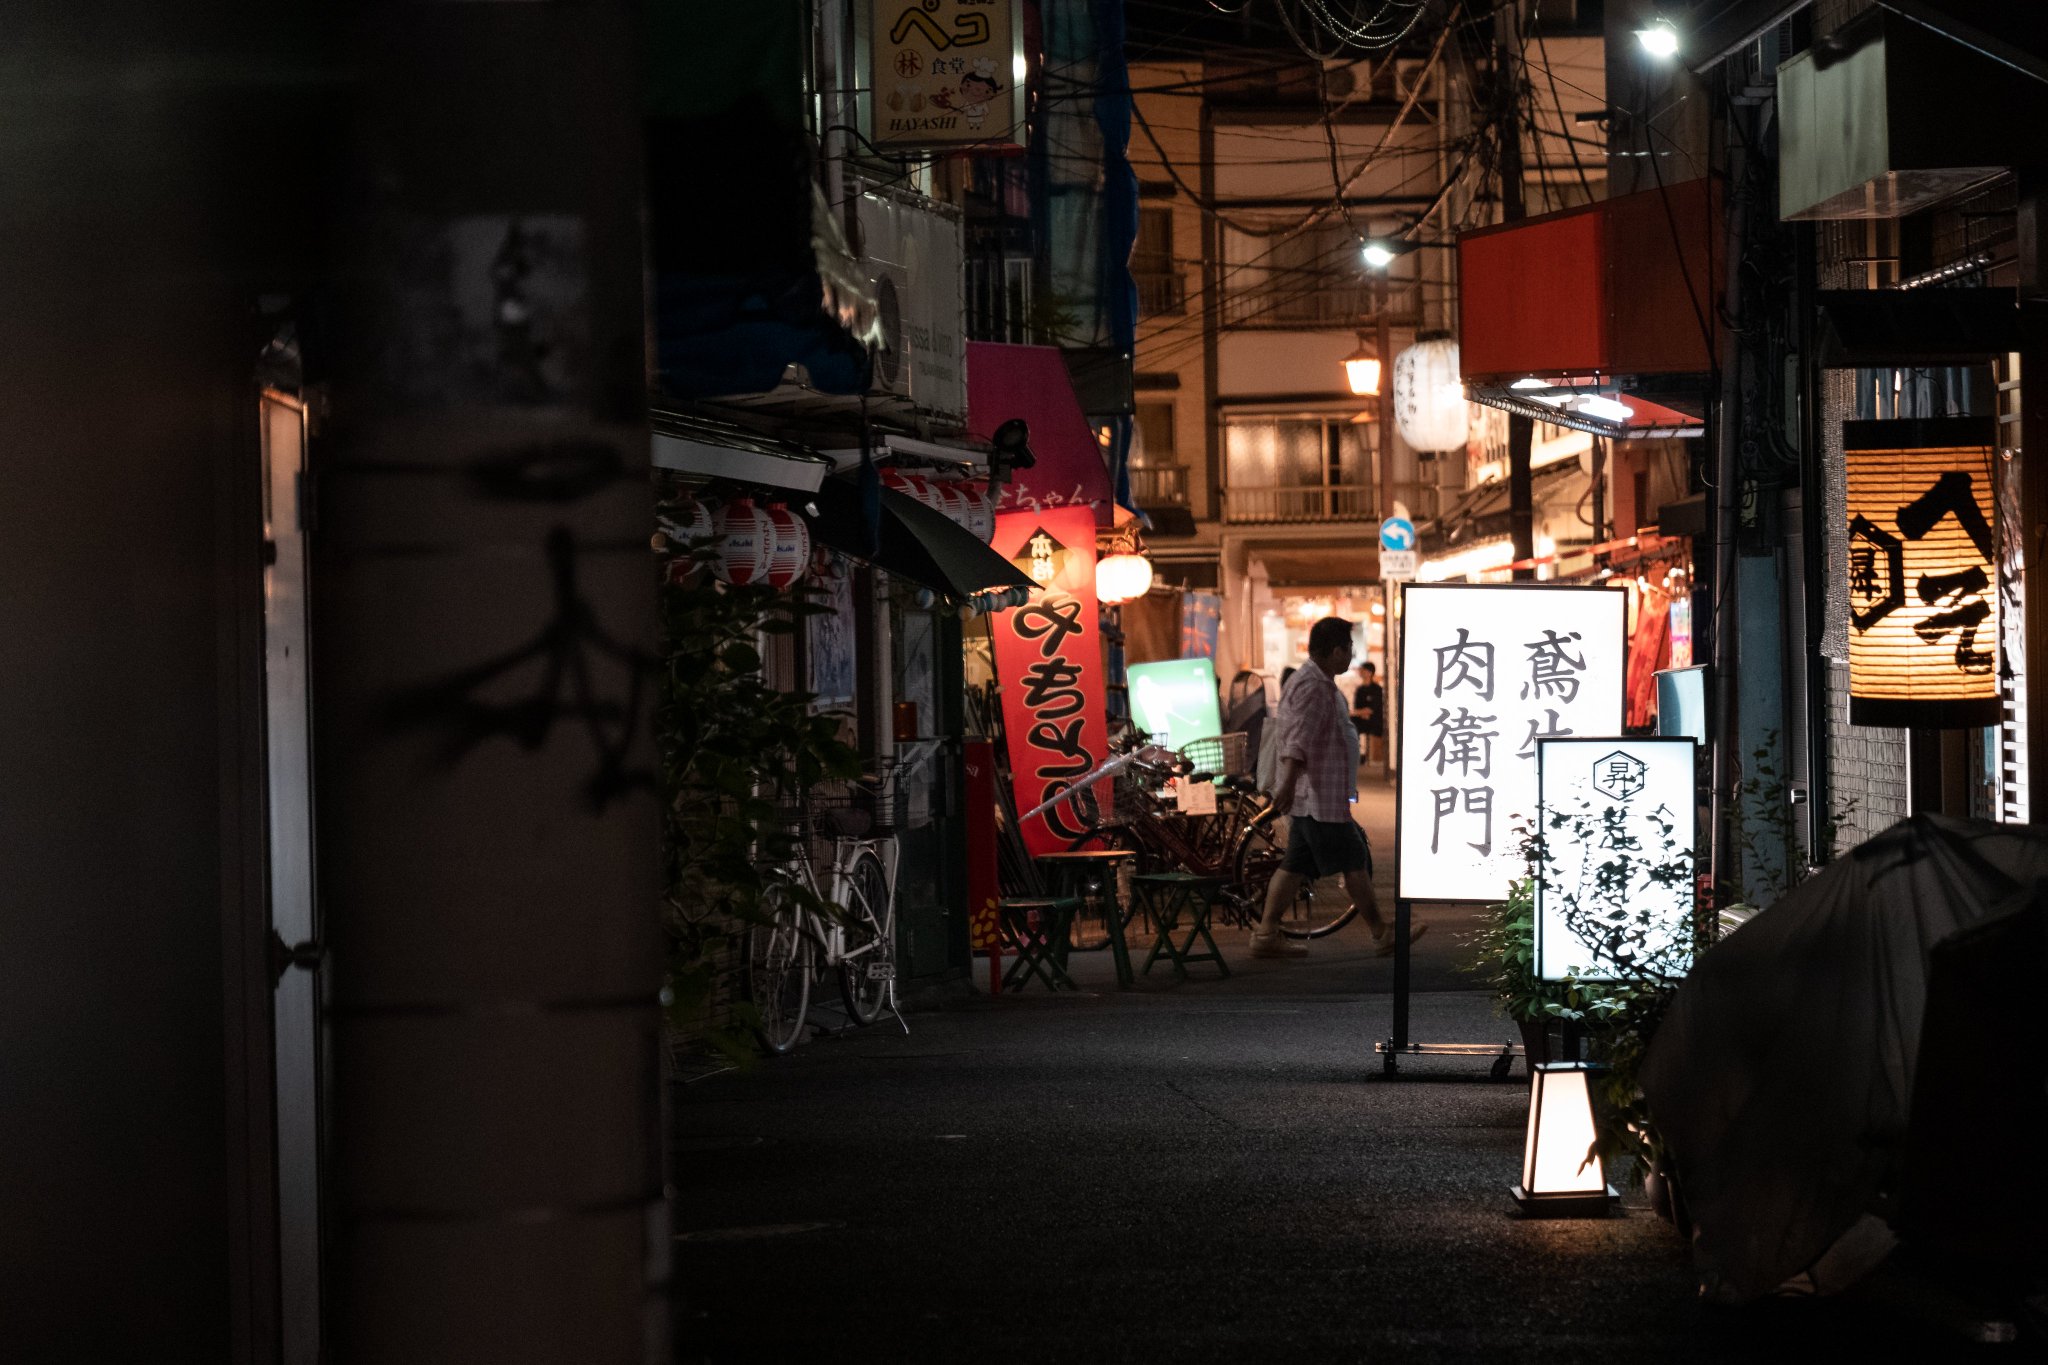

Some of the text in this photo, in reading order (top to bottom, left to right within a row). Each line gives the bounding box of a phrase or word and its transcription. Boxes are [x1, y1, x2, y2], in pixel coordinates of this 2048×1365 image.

[890, 0, 989, 51] ペコ
[898, 51, 965, 75] 林 食堂
[889, 117, 958, 131] HAYASHI
[728, 538, 753, 548] Asahi
[1424, 627, 1500, 858] 肉衛門
[1602, 762, 1637, 795] 昇
